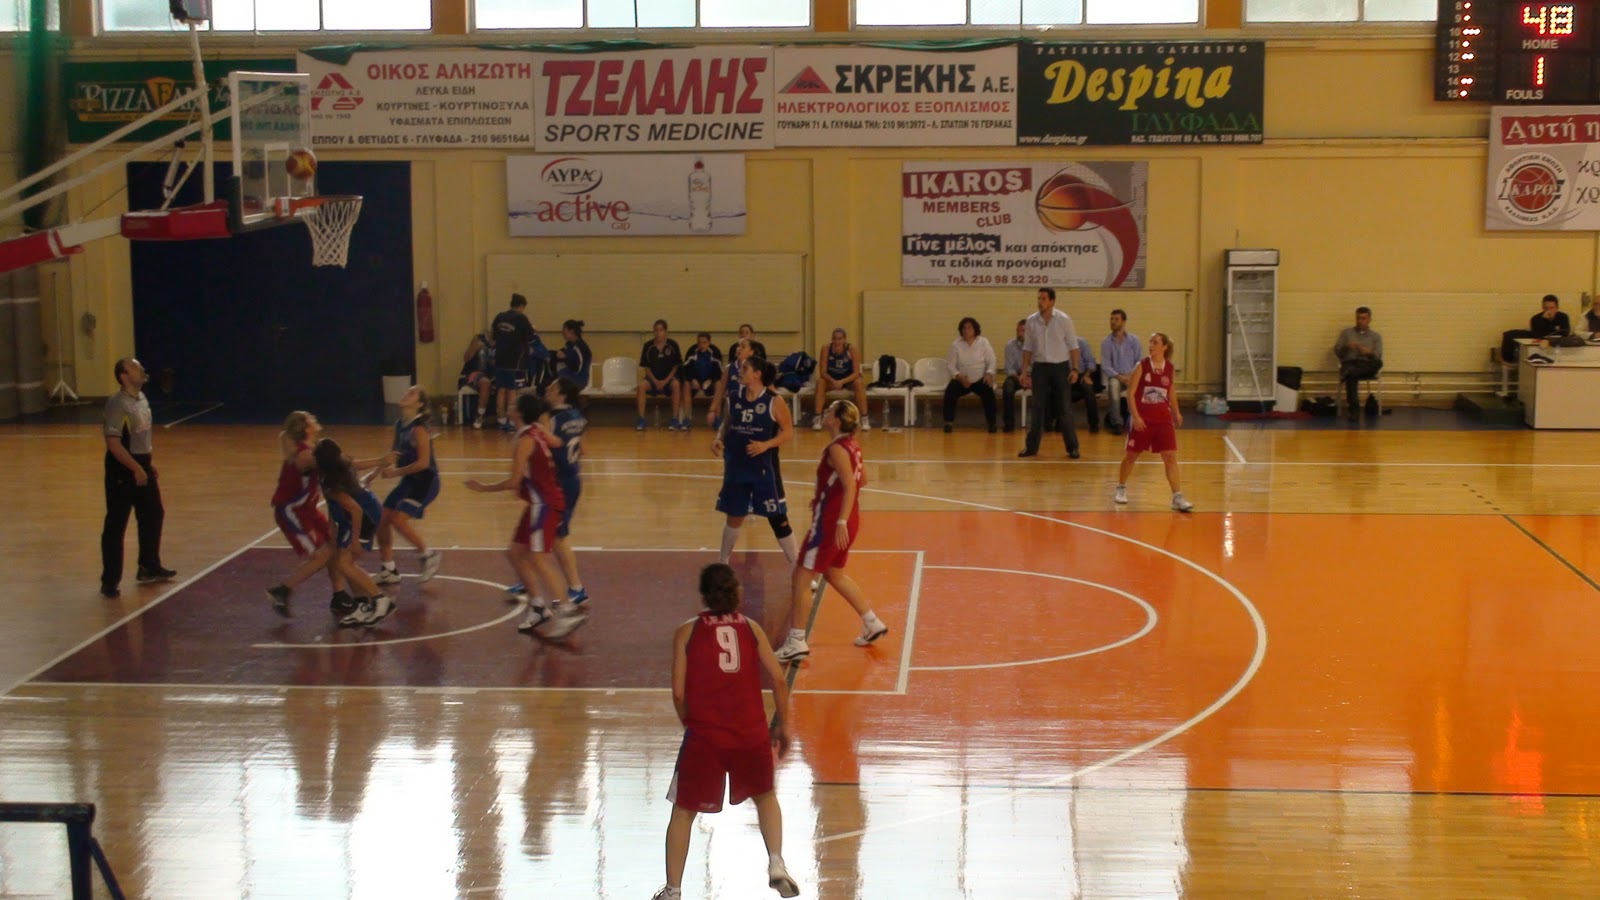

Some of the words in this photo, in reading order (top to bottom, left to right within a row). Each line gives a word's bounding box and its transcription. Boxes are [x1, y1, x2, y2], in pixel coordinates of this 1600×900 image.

[1523, 5, 1573, 34] 48
[1450, 28, 1461, 36] 10
[1037, 46, 1144, 55] PATISSERIE
[1156, 45, 1248, 54] CATERING
[1449, 40, 1460, 48] 11
[1522, 39, 1559, 50] HOME
[1448, 53, 1460, 61] 12
[367, 63, 430, 80] ΟΙΚΟΣ
[436, 62, 532, 80] ΑΛΗΖΩΤΗ
[1448, 65, 1460, 73] 13
[1536, 56, 1545, 85] 1
[835, 64, 976, 94] ΣΚΡΕΚΗΣ
[1044, 57, 1233, 111] Despina
[1447, 78, 1459, 86] 14
[416, 86, 449, 96] ΛΕΥΚΑ
[452, 86, 476, 96] ΕΙΔΗ
[542, 58, 768, 116] ΤΖΕΛΑΛΗΣ
[81, 84, 151, 112] PIZZA
[1446, 90, 1459, 98] 15
[1506, 89, 1544, 100] FOULS
[376, 102, 430, 111] ΚΟΥΡΤΙΝΕΣ
[439, 101, 530, 111] ΚΟΥΡΤΙΝΟΞΥΛΑ
[777, 101, 910, 114] ΗΛΕΚΤΡΟΛΟΓΙΚΟΣ
[914, 101, 1010, 114] ΕΞΟΠΛΙΣΜΟΣ
[390, 117, 445, 126] ΥΦΑΣΜΑΤΑ
[447, 116, 512, 126] ΕΠΙΠΛΩΣΕΩΝ
[882, 120, 896, 129] 210
[1131, 112, 1263, 132] ΓΛΥΦΑΔΑ
[544, 124, 640, 142] SPORTS
[648, 122, 764, 141] MEDICINE
[1505, 118, 1577, 142] Αυτή
[312, 135, 344, 144] ΕΠΠΟΥ
[358, 135, 400, 144] ΘΕΤΙΔΟΣ
[416, 134, 462, 144] ΓΛΥΦΑΔΑ
[470, 134, 487, 144] 210
[910, 170, 1024, 195] IKAROS
[538, 194, 630, 222] active
[922, 201, 1000, 214] MEMBERS
[976, 214, 1012, 228] CLUB
[906, 235, 941, 251] Γίνε
[944, 235, 996, 254] μέλος
[1005, 244, 1028, 254] και
[1031, 242, 1099, 256] απόκτησε
[930, 258, 946, 268] τα
[950, 256, 993, 268] ειδικά
[996, 256, 1066, 272] προνόμια!
[946, 275, 968, 286] Τηλ.
[972, 276, 992, 284] 210
[994, 276, 1008, 284] 98
[1012, 276, 1025, 284] 52
[1028, 276, 1048, 284] 220
[741, 408, 754, 423] 15
[764, 499, 777, 512] 15
[716, 625, 740, 673] 9
